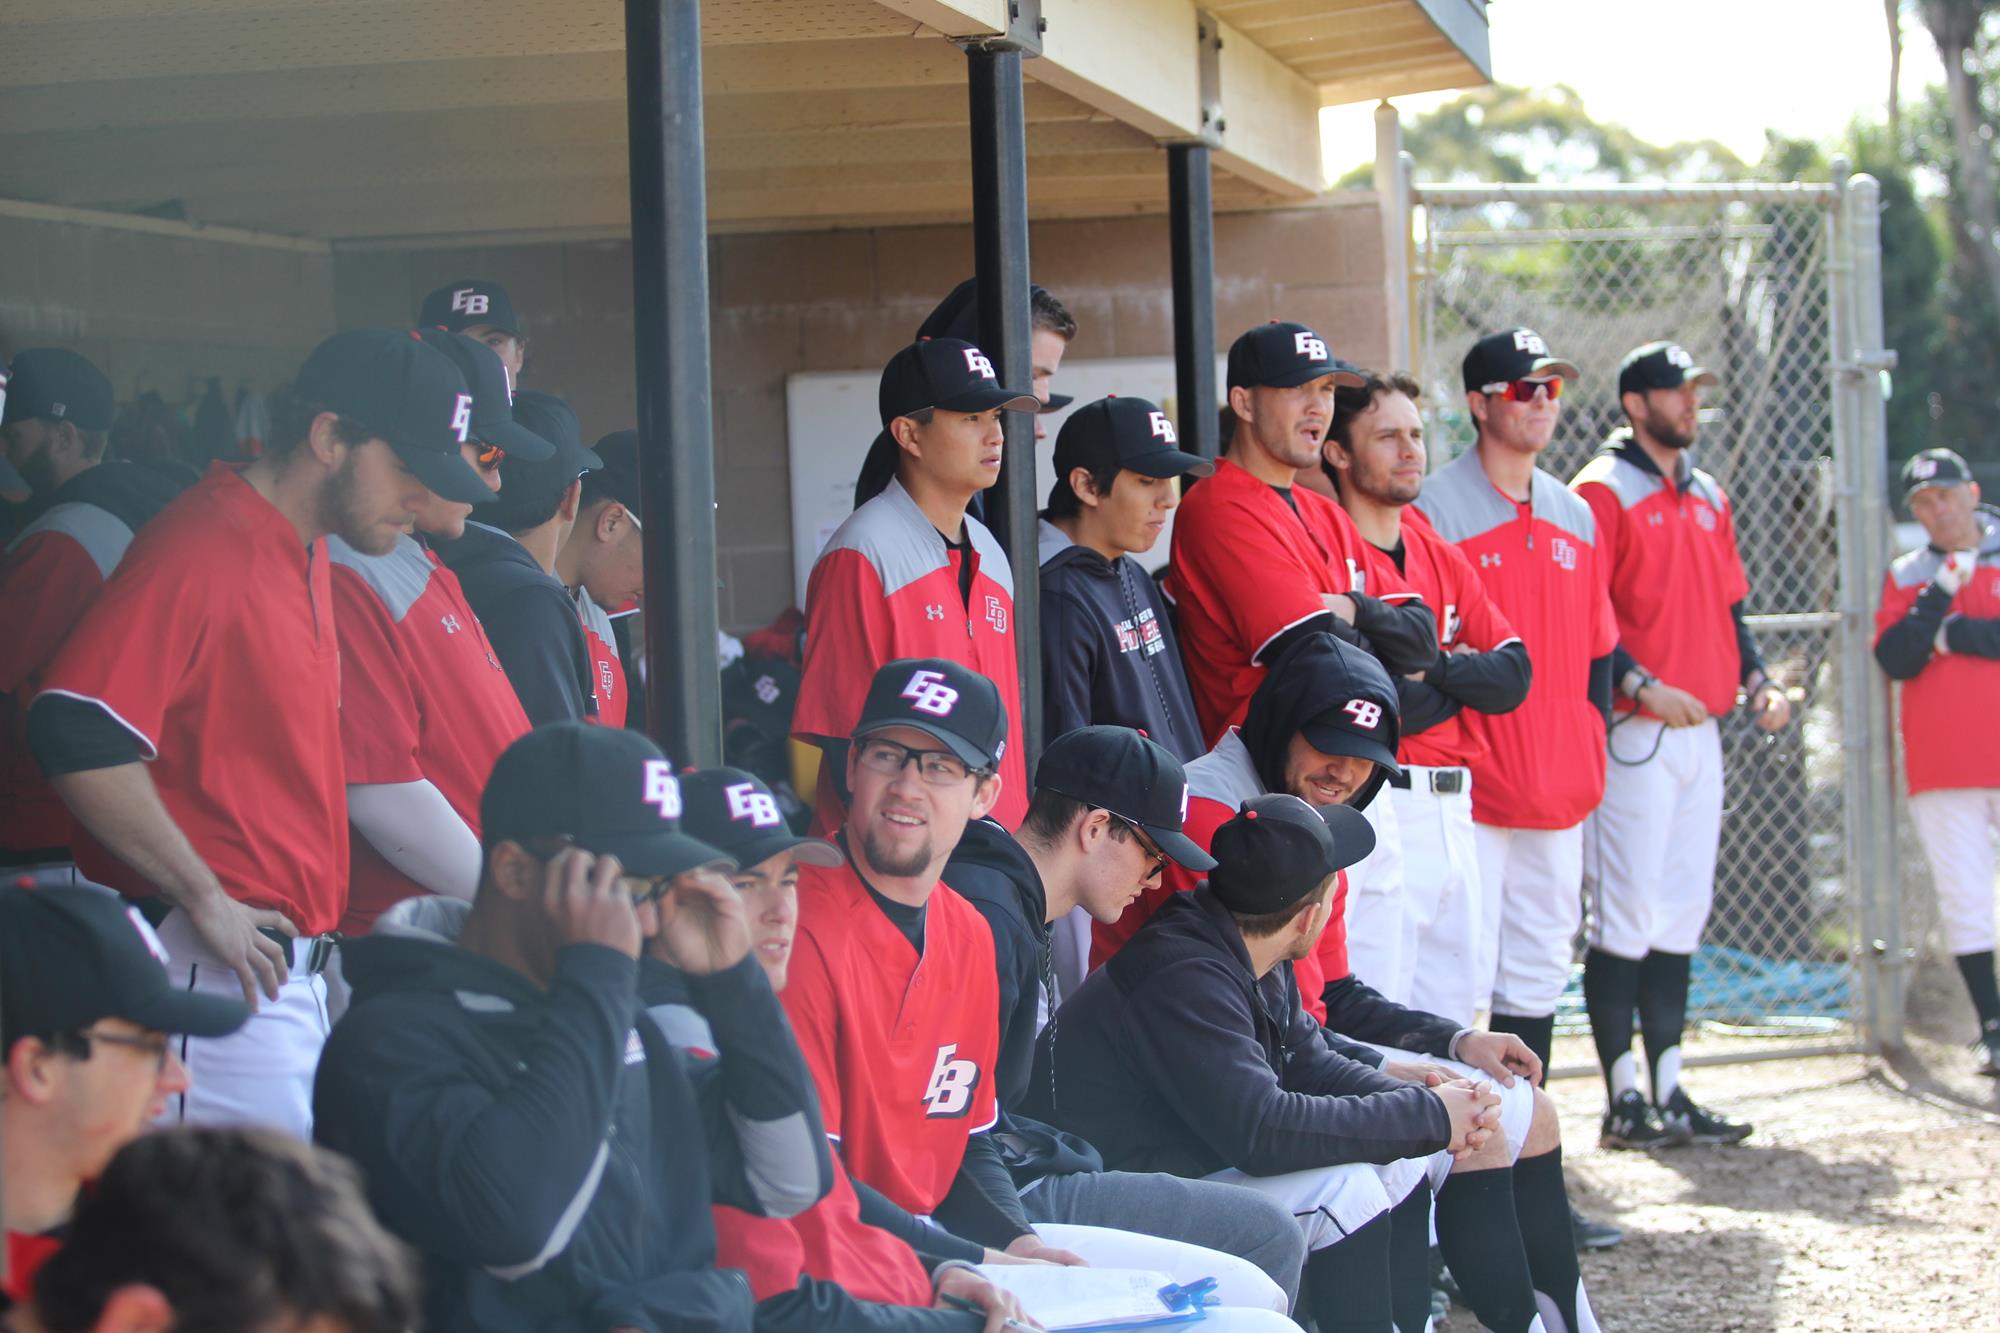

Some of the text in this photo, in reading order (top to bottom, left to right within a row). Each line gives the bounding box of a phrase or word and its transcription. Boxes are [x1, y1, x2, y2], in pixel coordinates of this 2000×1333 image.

[452, 288, 489, 315] EB
[1294, 331, 1328, 361] EB
[1513, 329, 1546, 355] EB
[961, 347, 996, 379] EB
[1148, 410, 1177, 444] EB
[1551, 537, 1577, 570] EB
[985, 595, 1008, 634] EB
[899, 669, 960, 717] EB
[642, 759, 683, 820] EB
[723, 781, 782, 829] EB
[921, 1043, 982, 1119] EB
